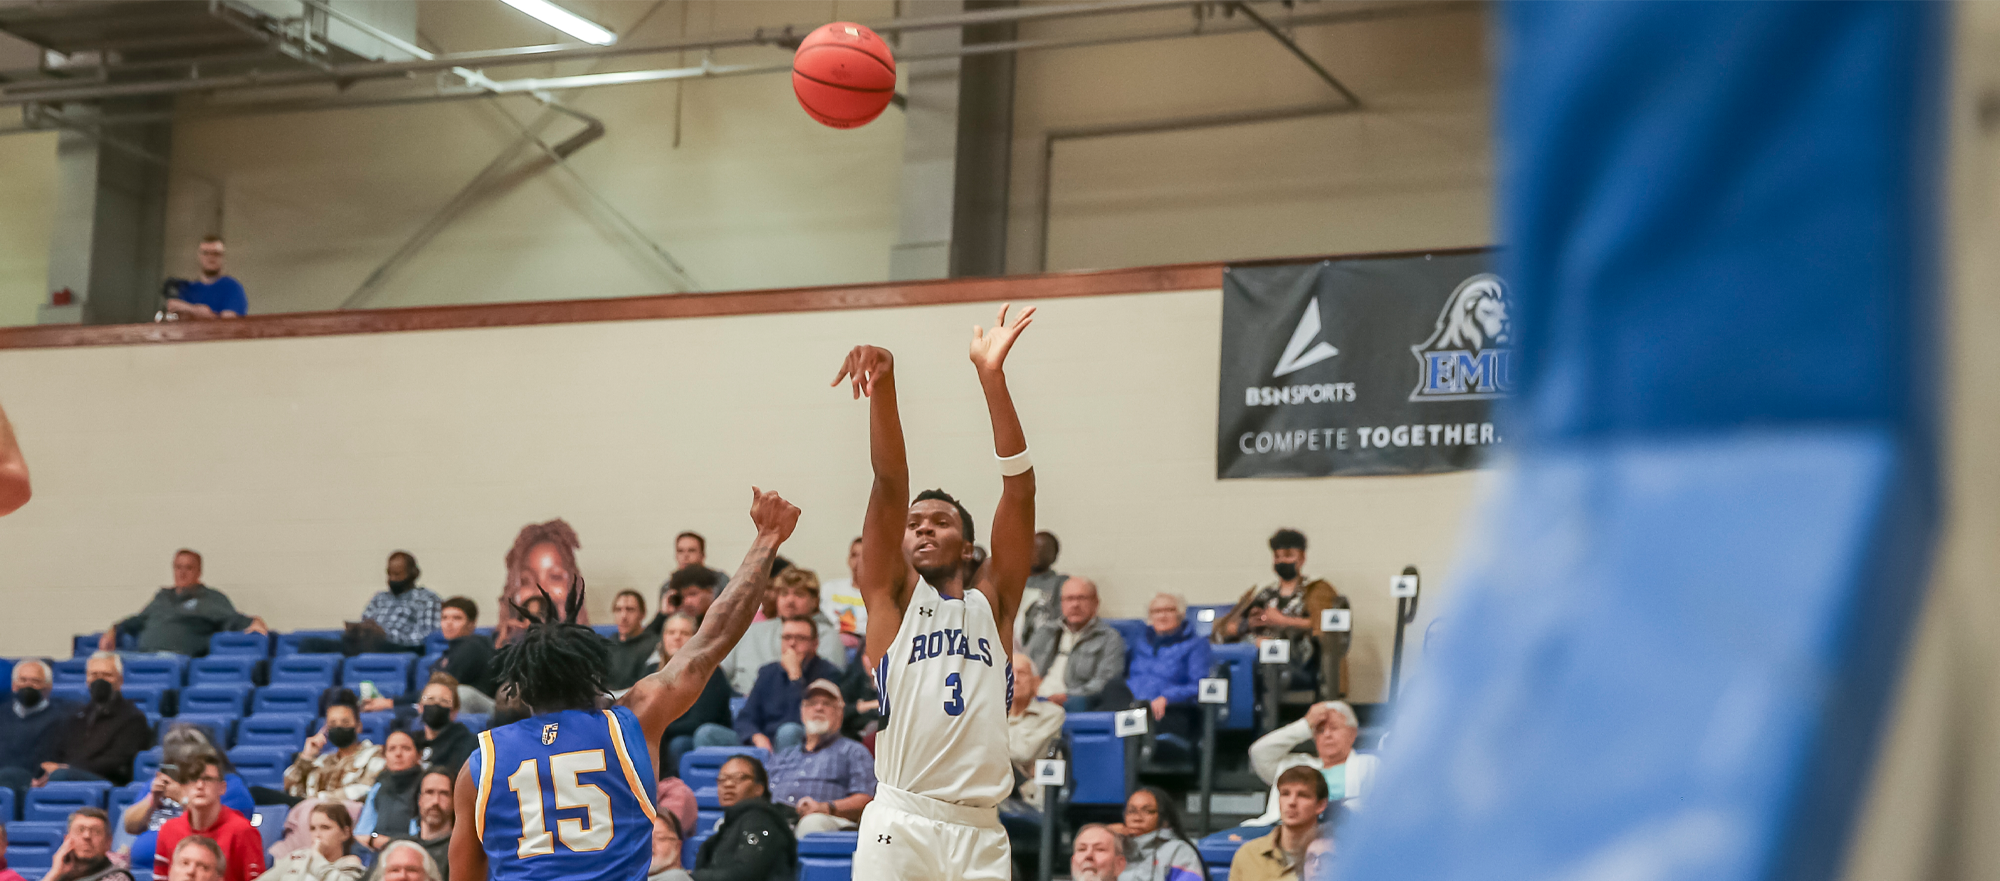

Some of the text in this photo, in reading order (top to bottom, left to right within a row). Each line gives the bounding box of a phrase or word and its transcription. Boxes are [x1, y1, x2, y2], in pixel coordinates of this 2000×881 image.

[1239, 422, 1502, 455] COMPETE TOGETHER.
[908, 629, 993, 667] ROYALS
[944, 672, 965, 717] 3
[507, 748, 614, 860] 15
